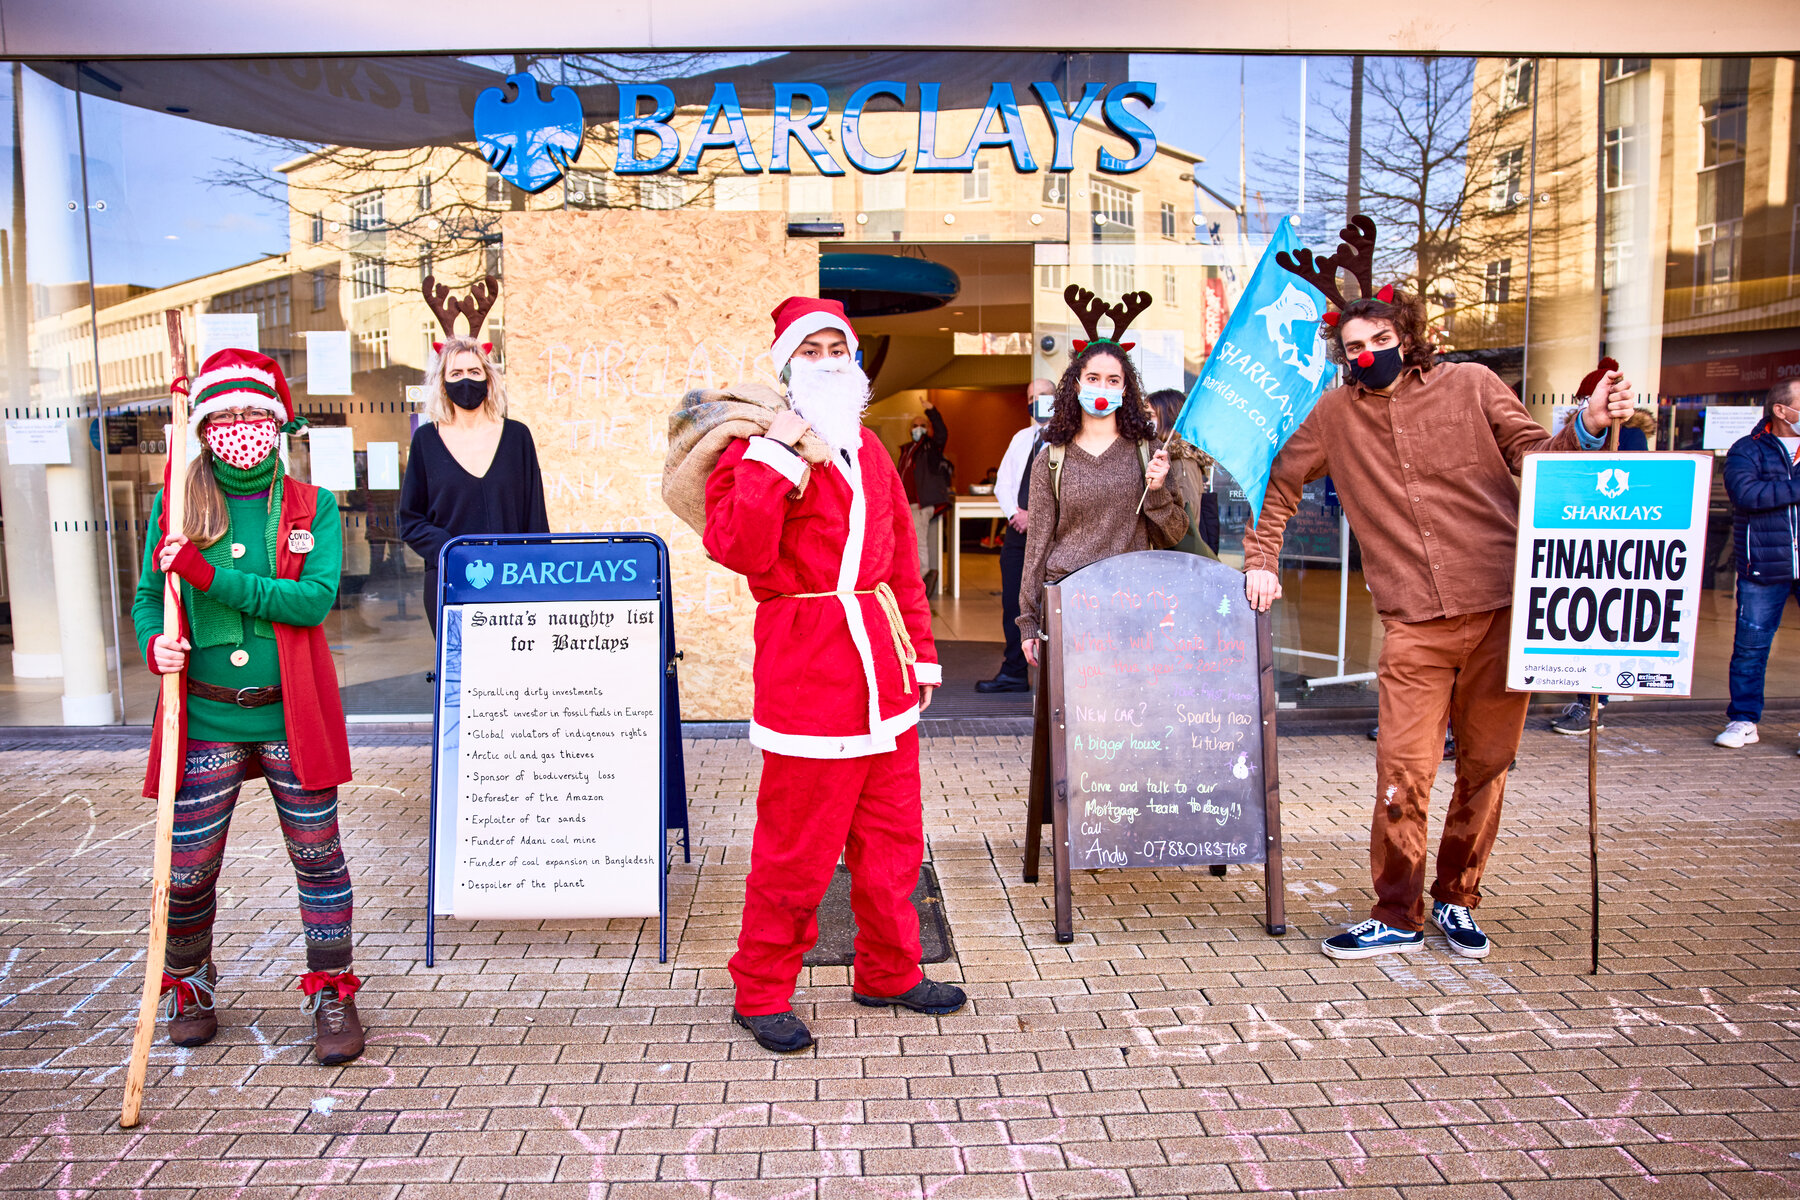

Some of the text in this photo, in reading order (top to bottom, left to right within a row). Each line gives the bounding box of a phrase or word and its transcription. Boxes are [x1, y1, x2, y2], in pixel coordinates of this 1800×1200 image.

[615, 80, 1157, 176] BARCLAYS
[1216, 341, 1294, 432] SHARKLAYS
[1561, 505, 1663, 521] SHARKLAYS
[288, 532, 311, 541] COVID
[1531, 538, 1687, 581] FINANCING
[501, 559, 637, 585] BARCLAYS
[471, 609, 655, 628] Santa's naughty list
[1526, 586, 1684, 643] ECOCIDE
[511, 634, 629, 653] for Barclays
[1073, 625, 1245, 662] What will Santa bring
[1075, 663, 1105, 688] you
[1112, 659, 1140, 673] this
[1524, 664, 1587, 674] sharklays.co.uk
[1535, 677, 1580, 687] @sharklays
[472, 688, 603, 700] Spiralling dirty investments
[472, 707, 654, 721] Largest investor in fossil fuels in Europe
[1177, 704, 1252, 733] Sparkly new
[472, 728, 648, 741] Global violators of indigenous rights
[1074, 726, 1174, 759] A bigger house?
[472, 750, 595, 763] Arctic oil and gas thieves
[472, 770, 615, 785] Sponsor of biodiversity loss
[1080, 772, 1218, 794] Come and talk to our
[472, 792, 604, 802] Deforester of the Amazon
[1084, 799, 1142, 824] Mortgage
[1146, 798, 1179, 815] team
[472, 813, 586, 828] Exploiter of tar sands
[1081, 822, 1102, 835] Call
[471, 835, 596, 846] Funder of Adani coal mine
[1086, 838, 1128, 866] Andy
[469, 855, 655, 868] Funder of coal expansion in Bangladesh
[468, 879, 585, 892] Despoiler of the planet
